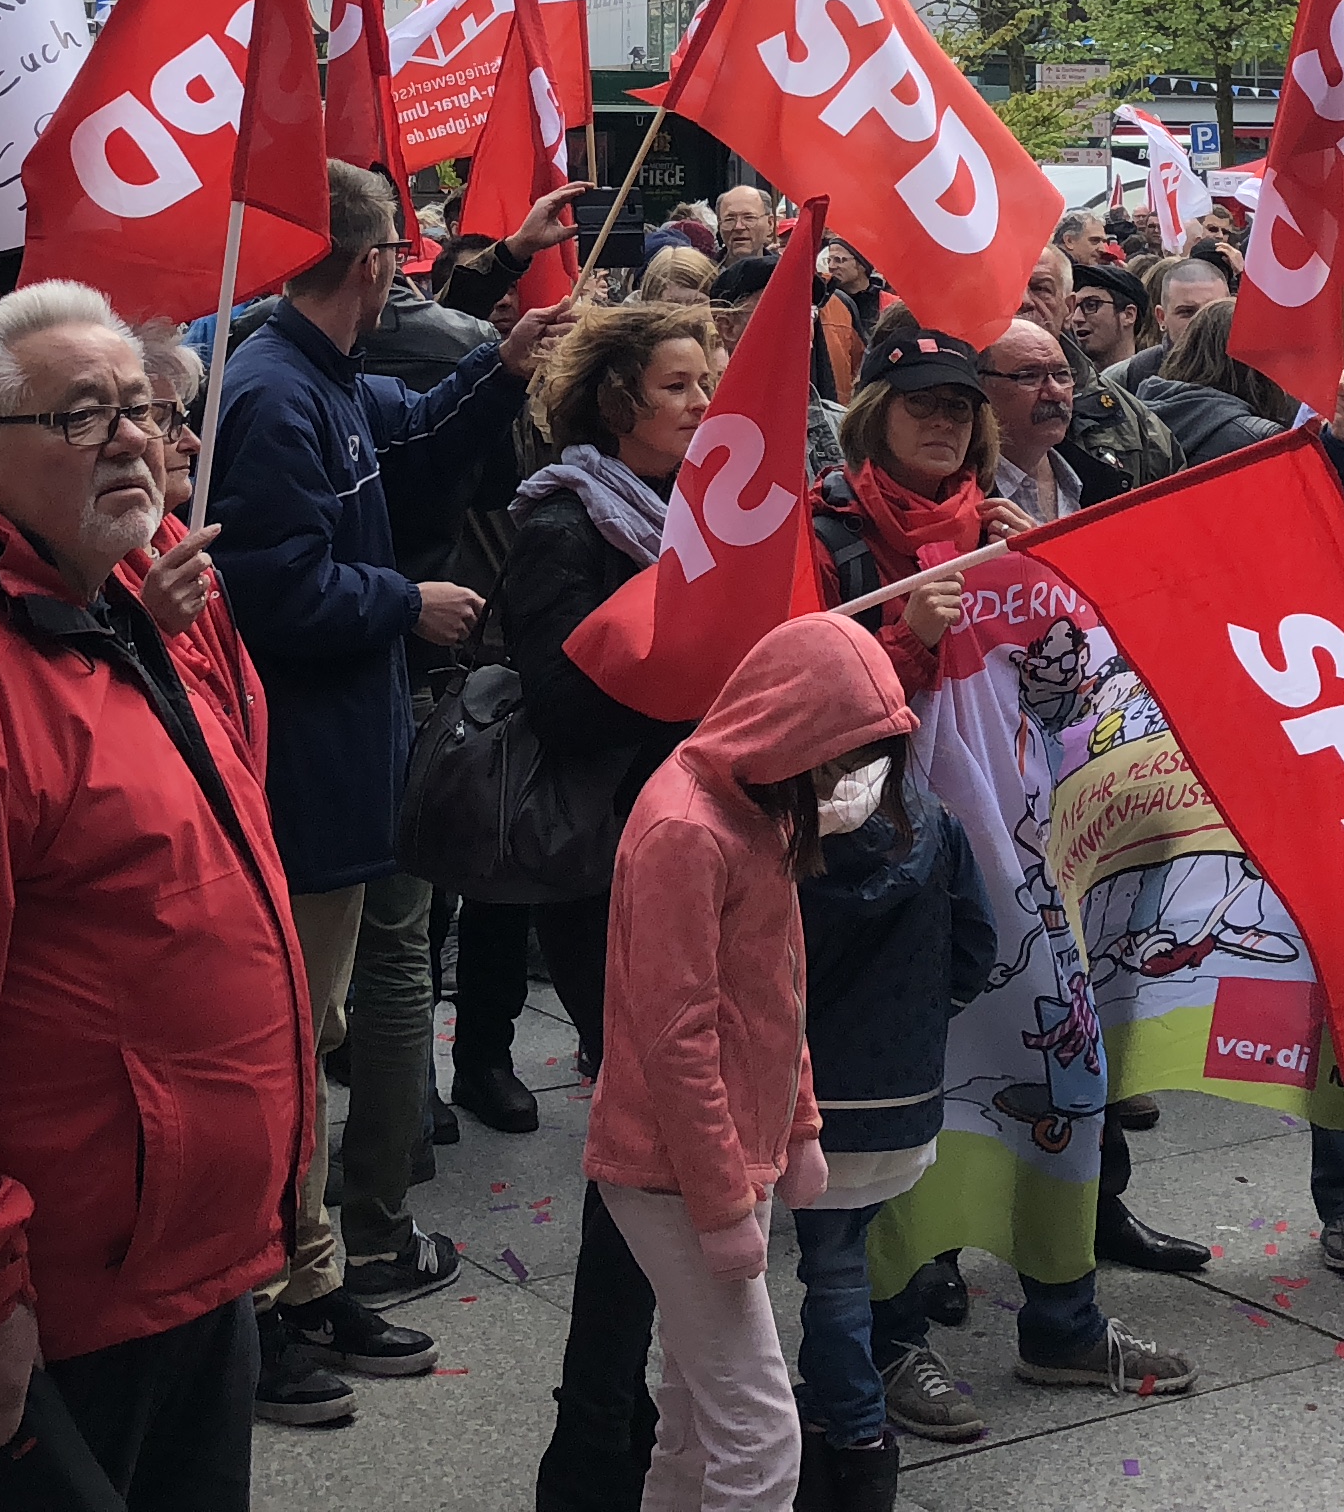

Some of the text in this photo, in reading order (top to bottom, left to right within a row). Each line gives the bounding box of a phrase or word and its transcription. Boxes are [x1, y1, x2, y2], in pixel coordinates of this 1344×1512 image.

[1197, 126, 1213, 151] P
[639, 164, 686, 187] FIEGE
[1215, 1035, 1312, 1073] ver.di
